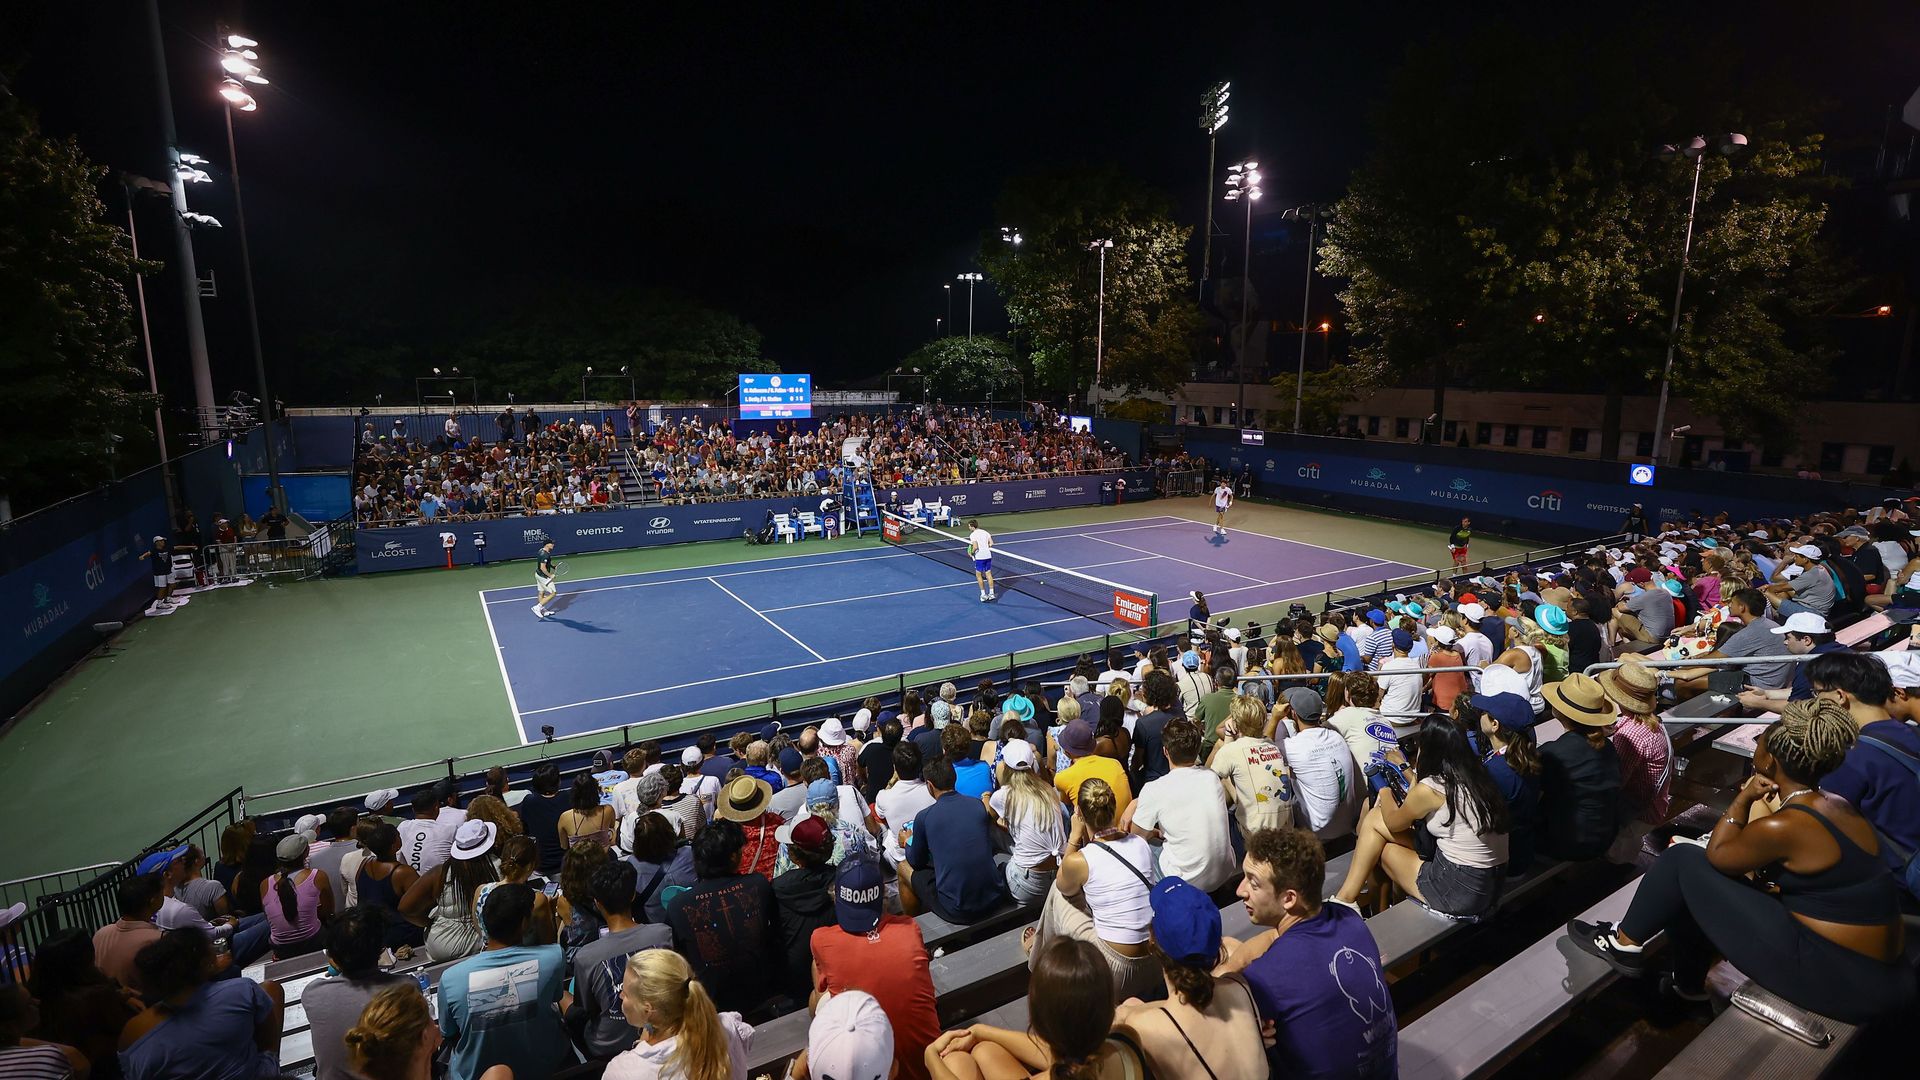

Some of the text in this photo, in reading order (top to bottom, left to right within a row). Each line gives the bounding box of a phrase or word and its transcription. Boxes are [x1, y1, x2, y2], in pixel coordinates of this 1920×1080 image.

[1297, 465, 1321, 479] citi
[1350, 479, 1401, 491] MUBADALA
[950, 494, 967, 503] ATP
[1430, 489, 1489, 504] MUBADALA
[1527, 494, 1562, 511] citi
[523, 533, 550, 542] TENNIS
[371, 548, 417, 559] LACOSTE
[1115, 595, 1148, 614] Emirates
[23, 600, 70, 639] MUBADALA
[1247, 757, 1260, 765] My
[695, 892, 713, 900] POST
[846, 885, 880, 904] BOARD
